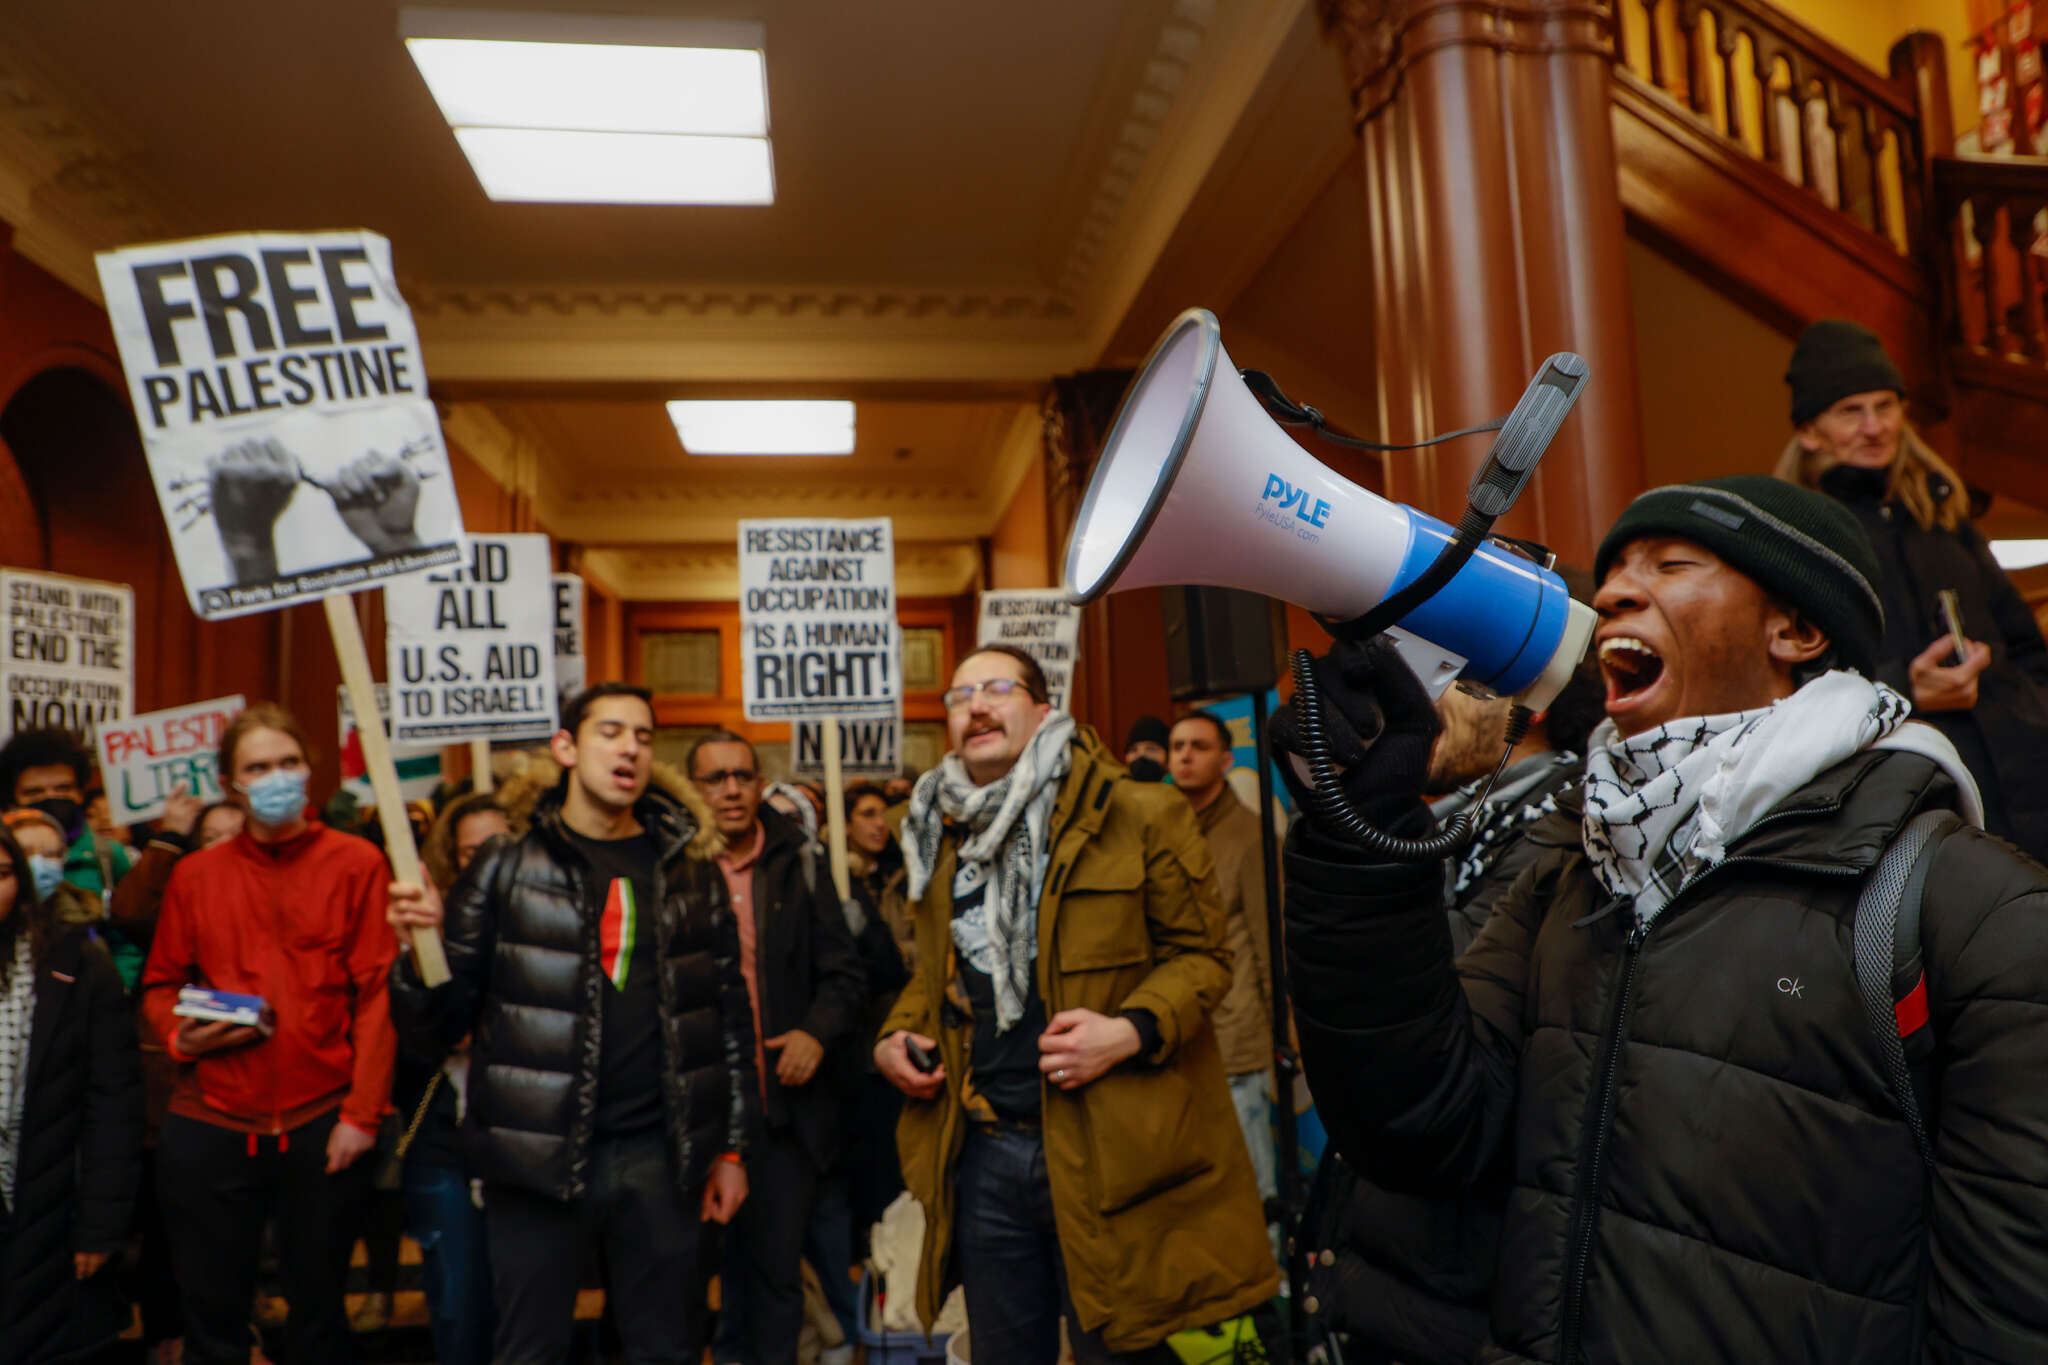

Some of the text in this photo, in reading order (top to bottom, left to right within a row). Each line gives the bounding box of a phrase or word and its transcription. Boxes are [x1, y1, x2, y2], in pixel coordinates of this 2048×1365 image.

[131, 247, 389, 368] FREE
[142, 345, 413, 429] PALESTINE
[1262, 472, 1331, 529] PYLE
[747, 527, 884, 553] RESISTANCE
[428, 543, 509, 583] ND
[769, 557, 865, 582] AGAINST
[436, 588, 507, 630] ALL
[747, 586, 889, 612] OCCUPATION
[12, 630, 120, 670] END THE
[753, 623, 890, 648] IS A HUMAN
[401, 645, 539, 684] U.S. AID
[756, 651, 890, 699] RIGHT!
[400, 690, 432, 717] TO
[443, 687, 544, 716] ISRAEL!
